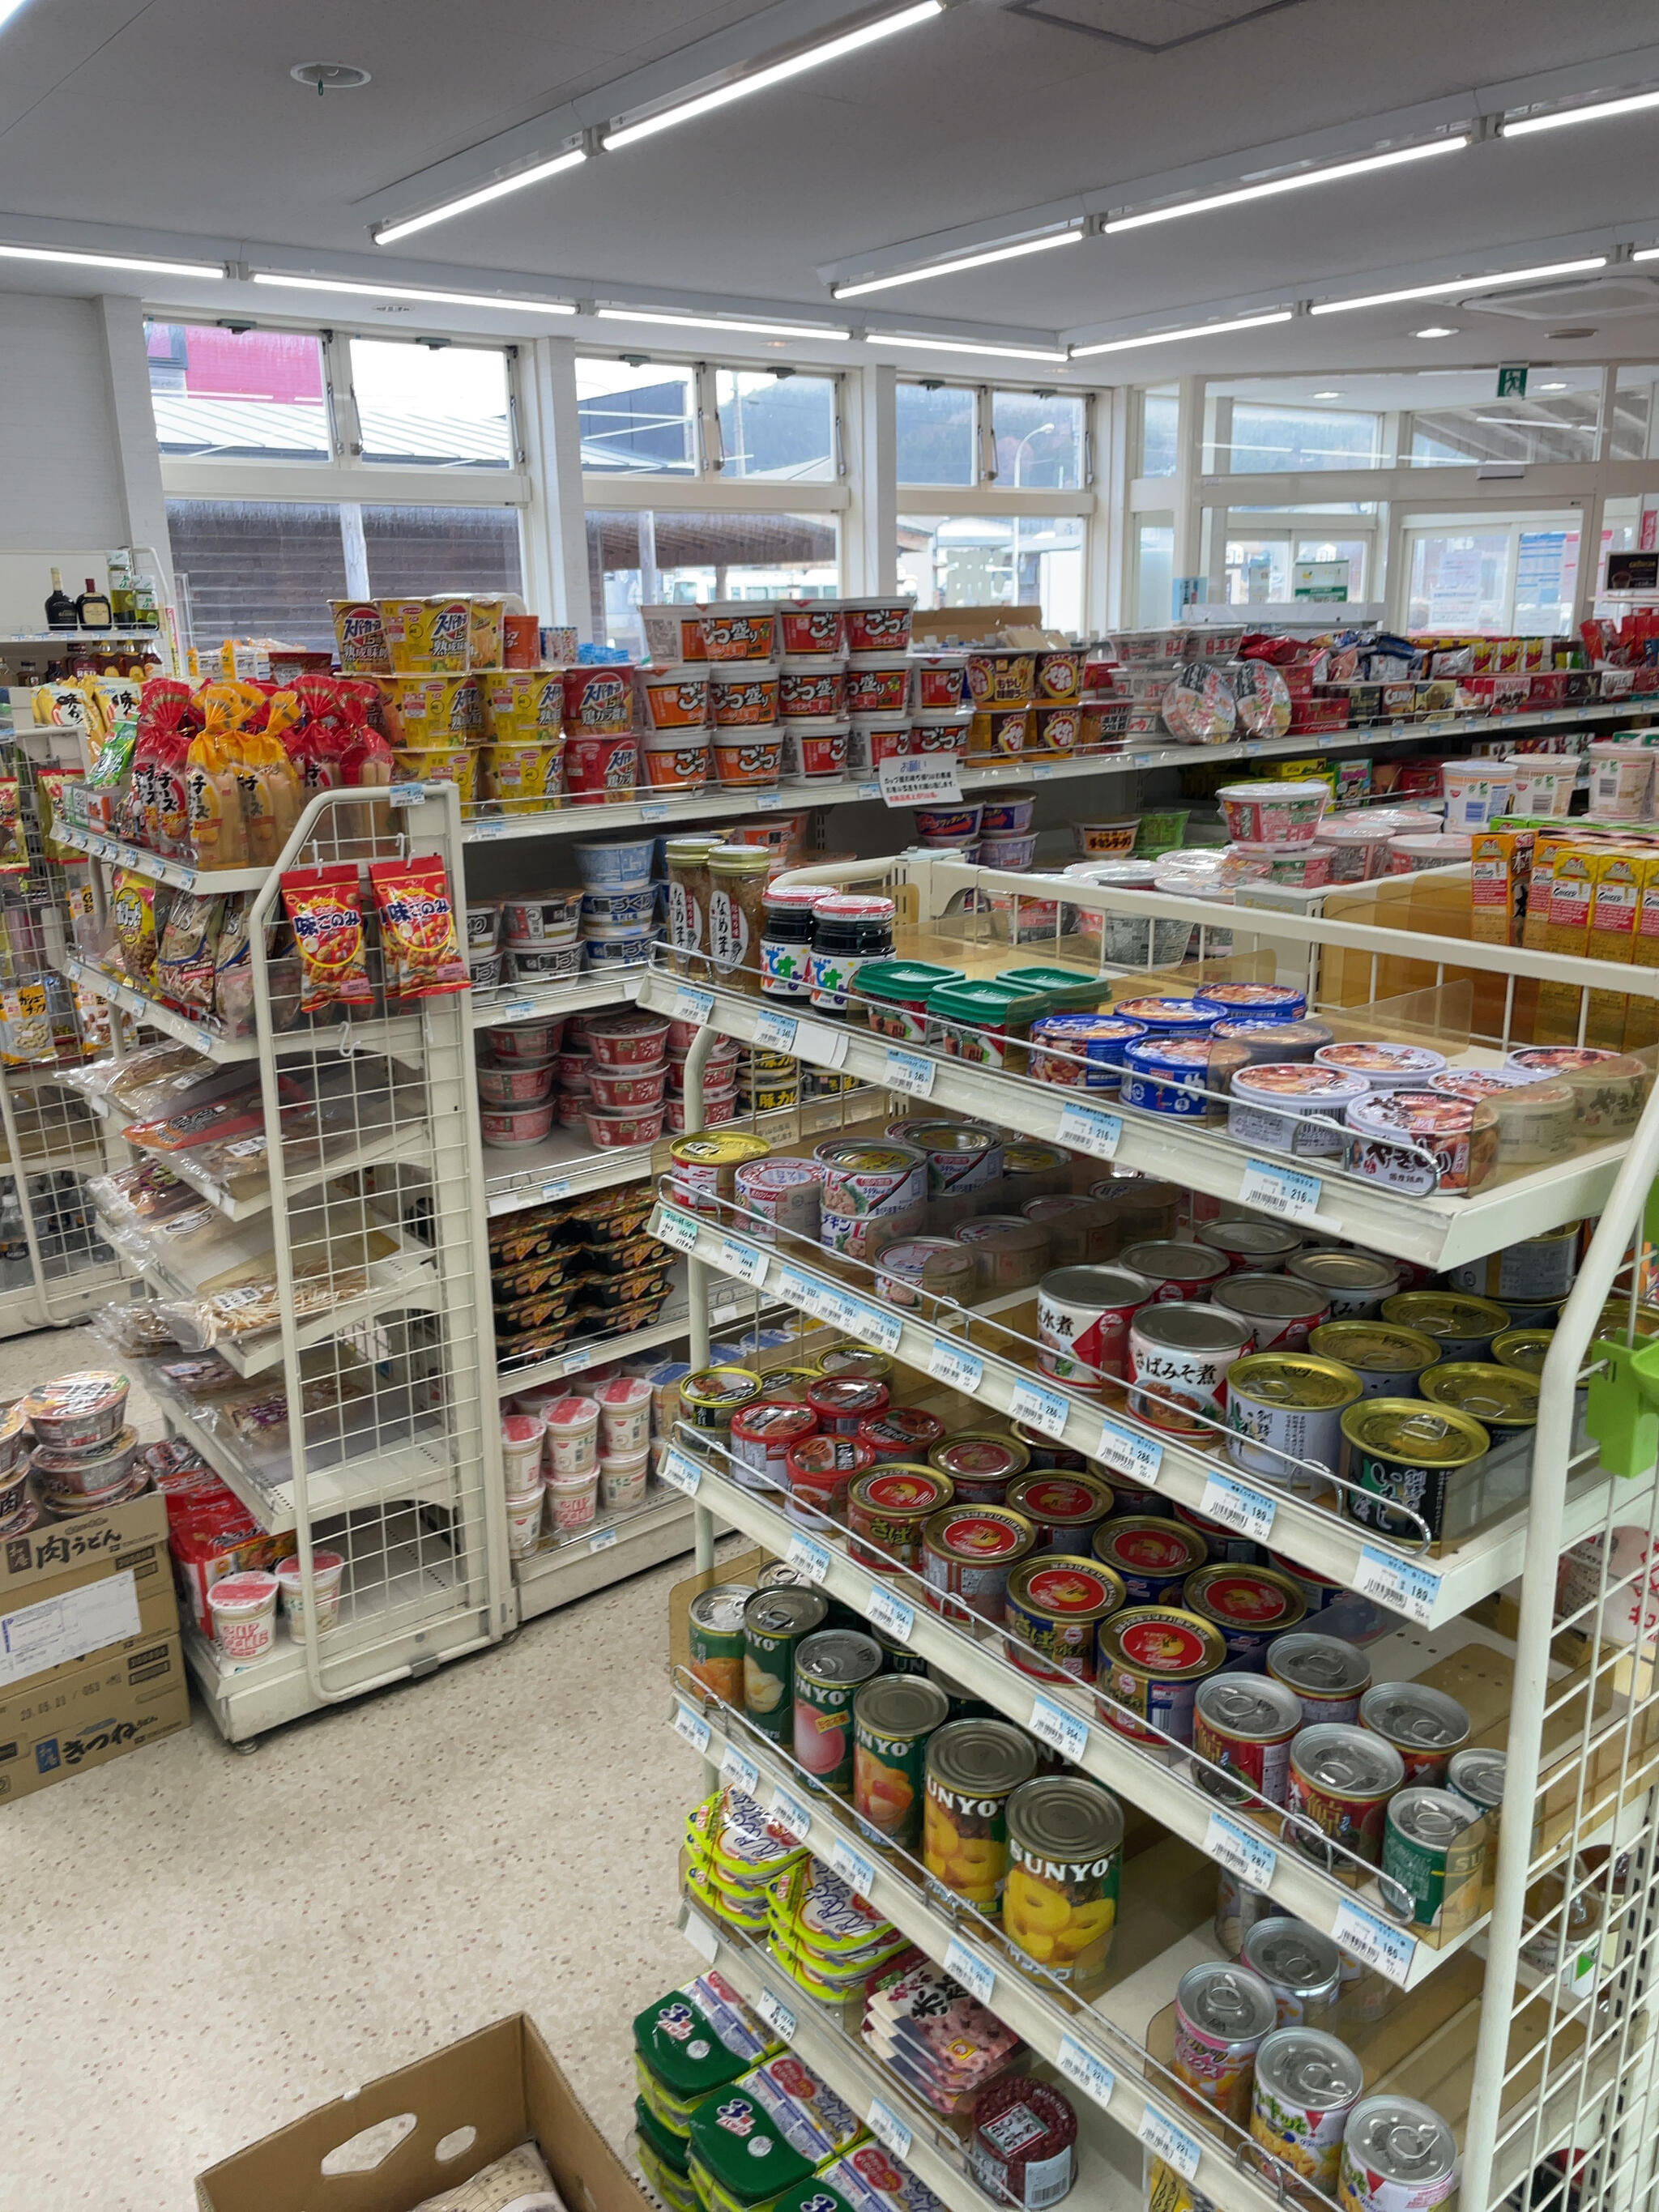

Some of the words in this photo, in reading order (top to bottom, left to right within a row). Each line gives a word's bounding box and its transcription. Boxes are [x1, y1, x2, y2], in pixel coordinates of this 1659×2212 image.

[159, 771, 178, 813] チーズ
[293, 910, 361, 937] 味このみ
[386, 897, 452, 924] 味このみ
[1290, 1188, 1308, 1202] 216
[1135, 1349, 1218, 1386] さばみそ煮
[36, 1528, 123, 1570] 肉うどん
[1009, 1837, 1111, 1883] SUNYO
